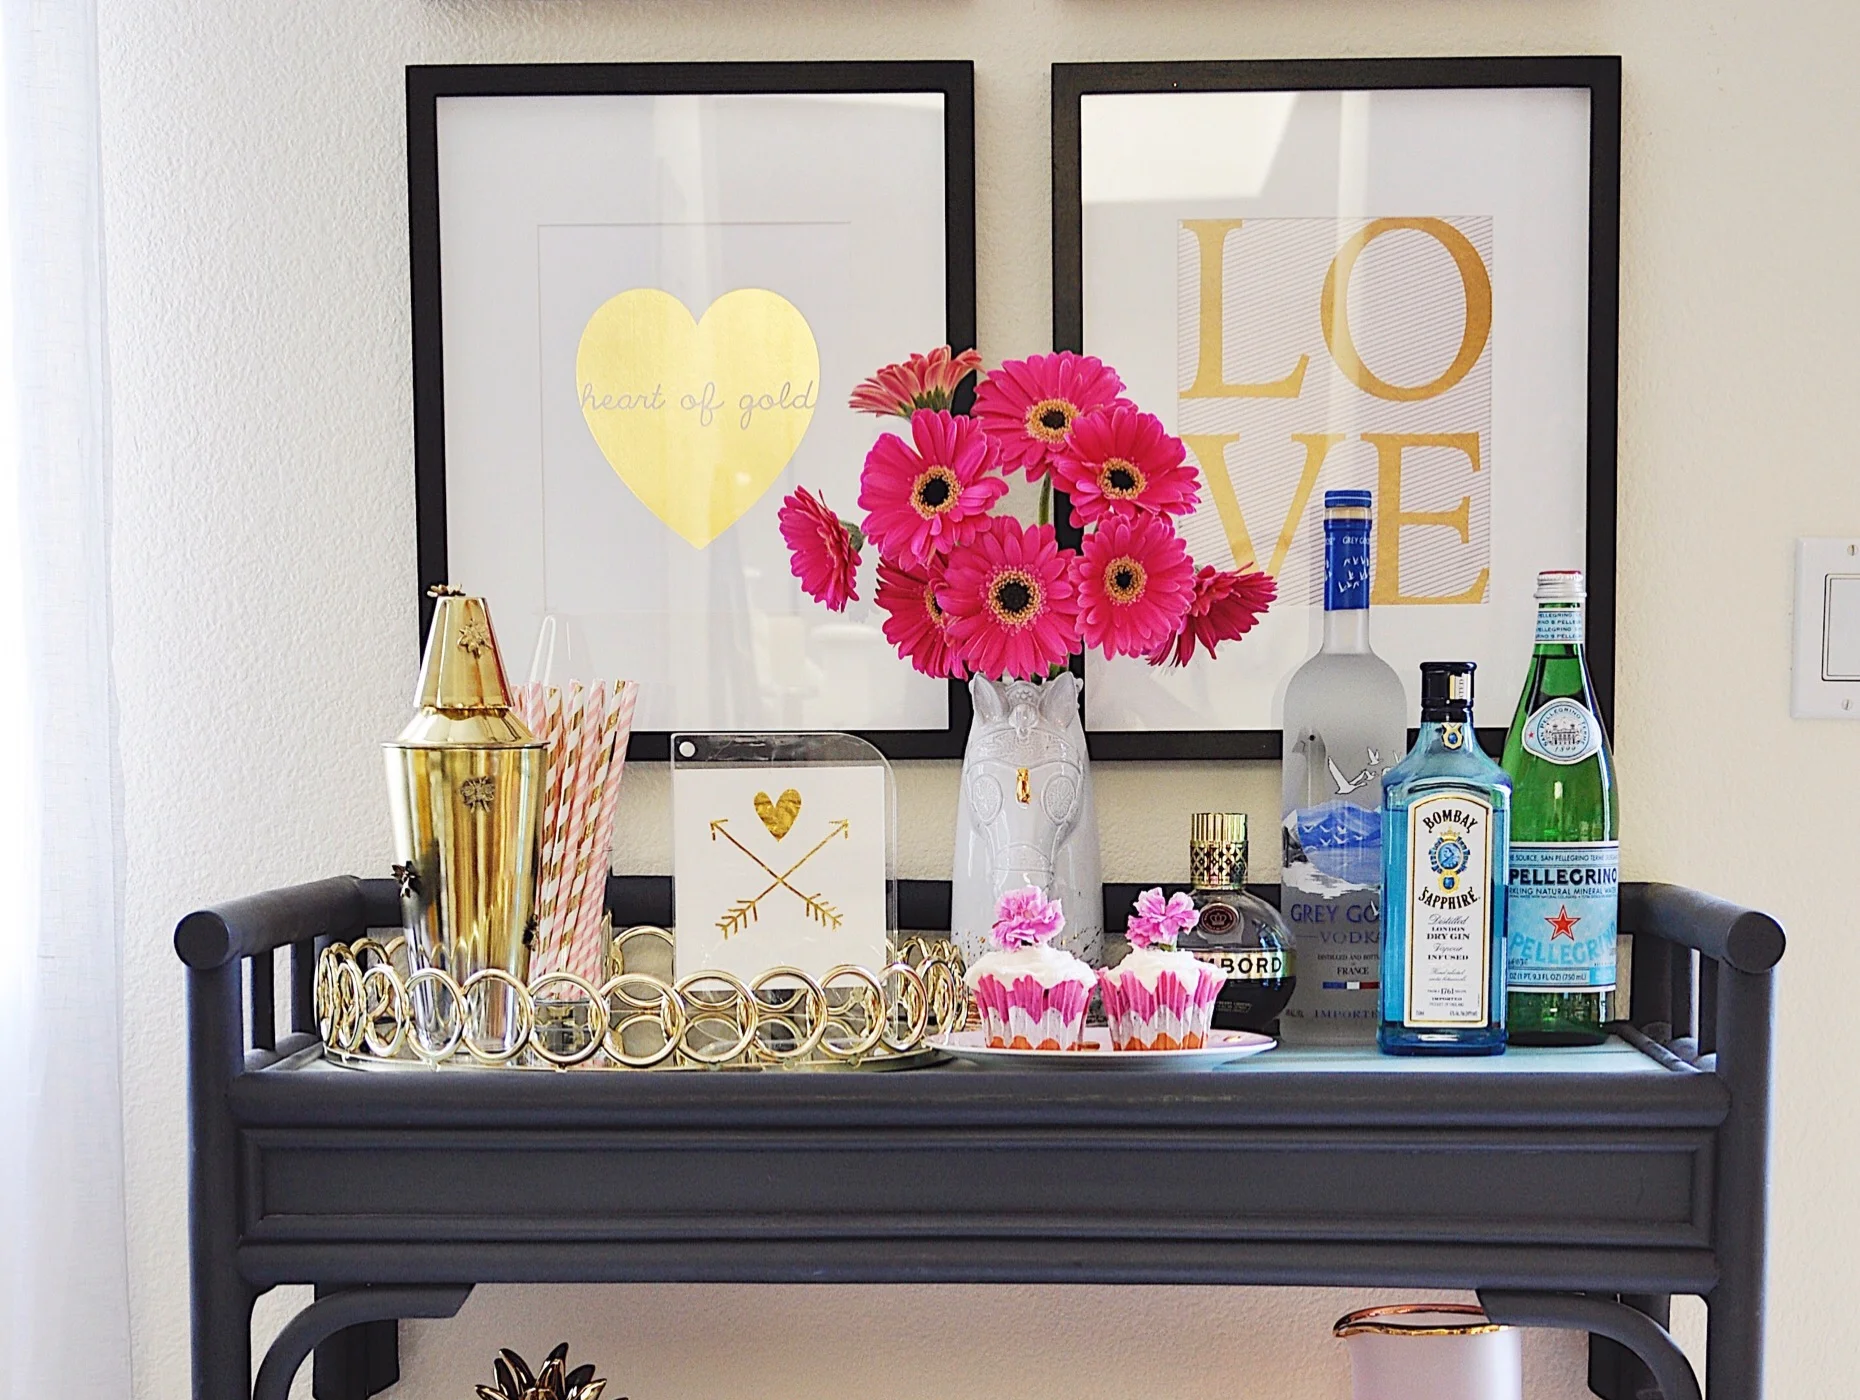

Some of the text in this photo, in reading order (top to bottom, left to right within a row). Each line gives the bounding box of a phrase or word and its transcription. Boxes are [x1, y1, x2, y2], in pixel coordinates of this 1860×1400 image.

[1179, 216, 1492, 402] LO
[581, 380, 816, 430] heart of gold
[1178, 431, 1490, 605] VE
[1422, 809, 1478, 834] BOMBAY
[1555, 854, 1589, 862] PELLEGRINO
[1509, 867, 1617, 886] PELLEGRINO
[1418, 886, 1478, 910] SAPPHIRE
[1573, 887, 1603, 895] MINERAL
[1291, 903, 1338, 923] GREY
[1428, 913, 1470, 925] Distilled
[1320, 931, 1380, 944] VODK
[1337, 966, 1370, 975] FRANCE
